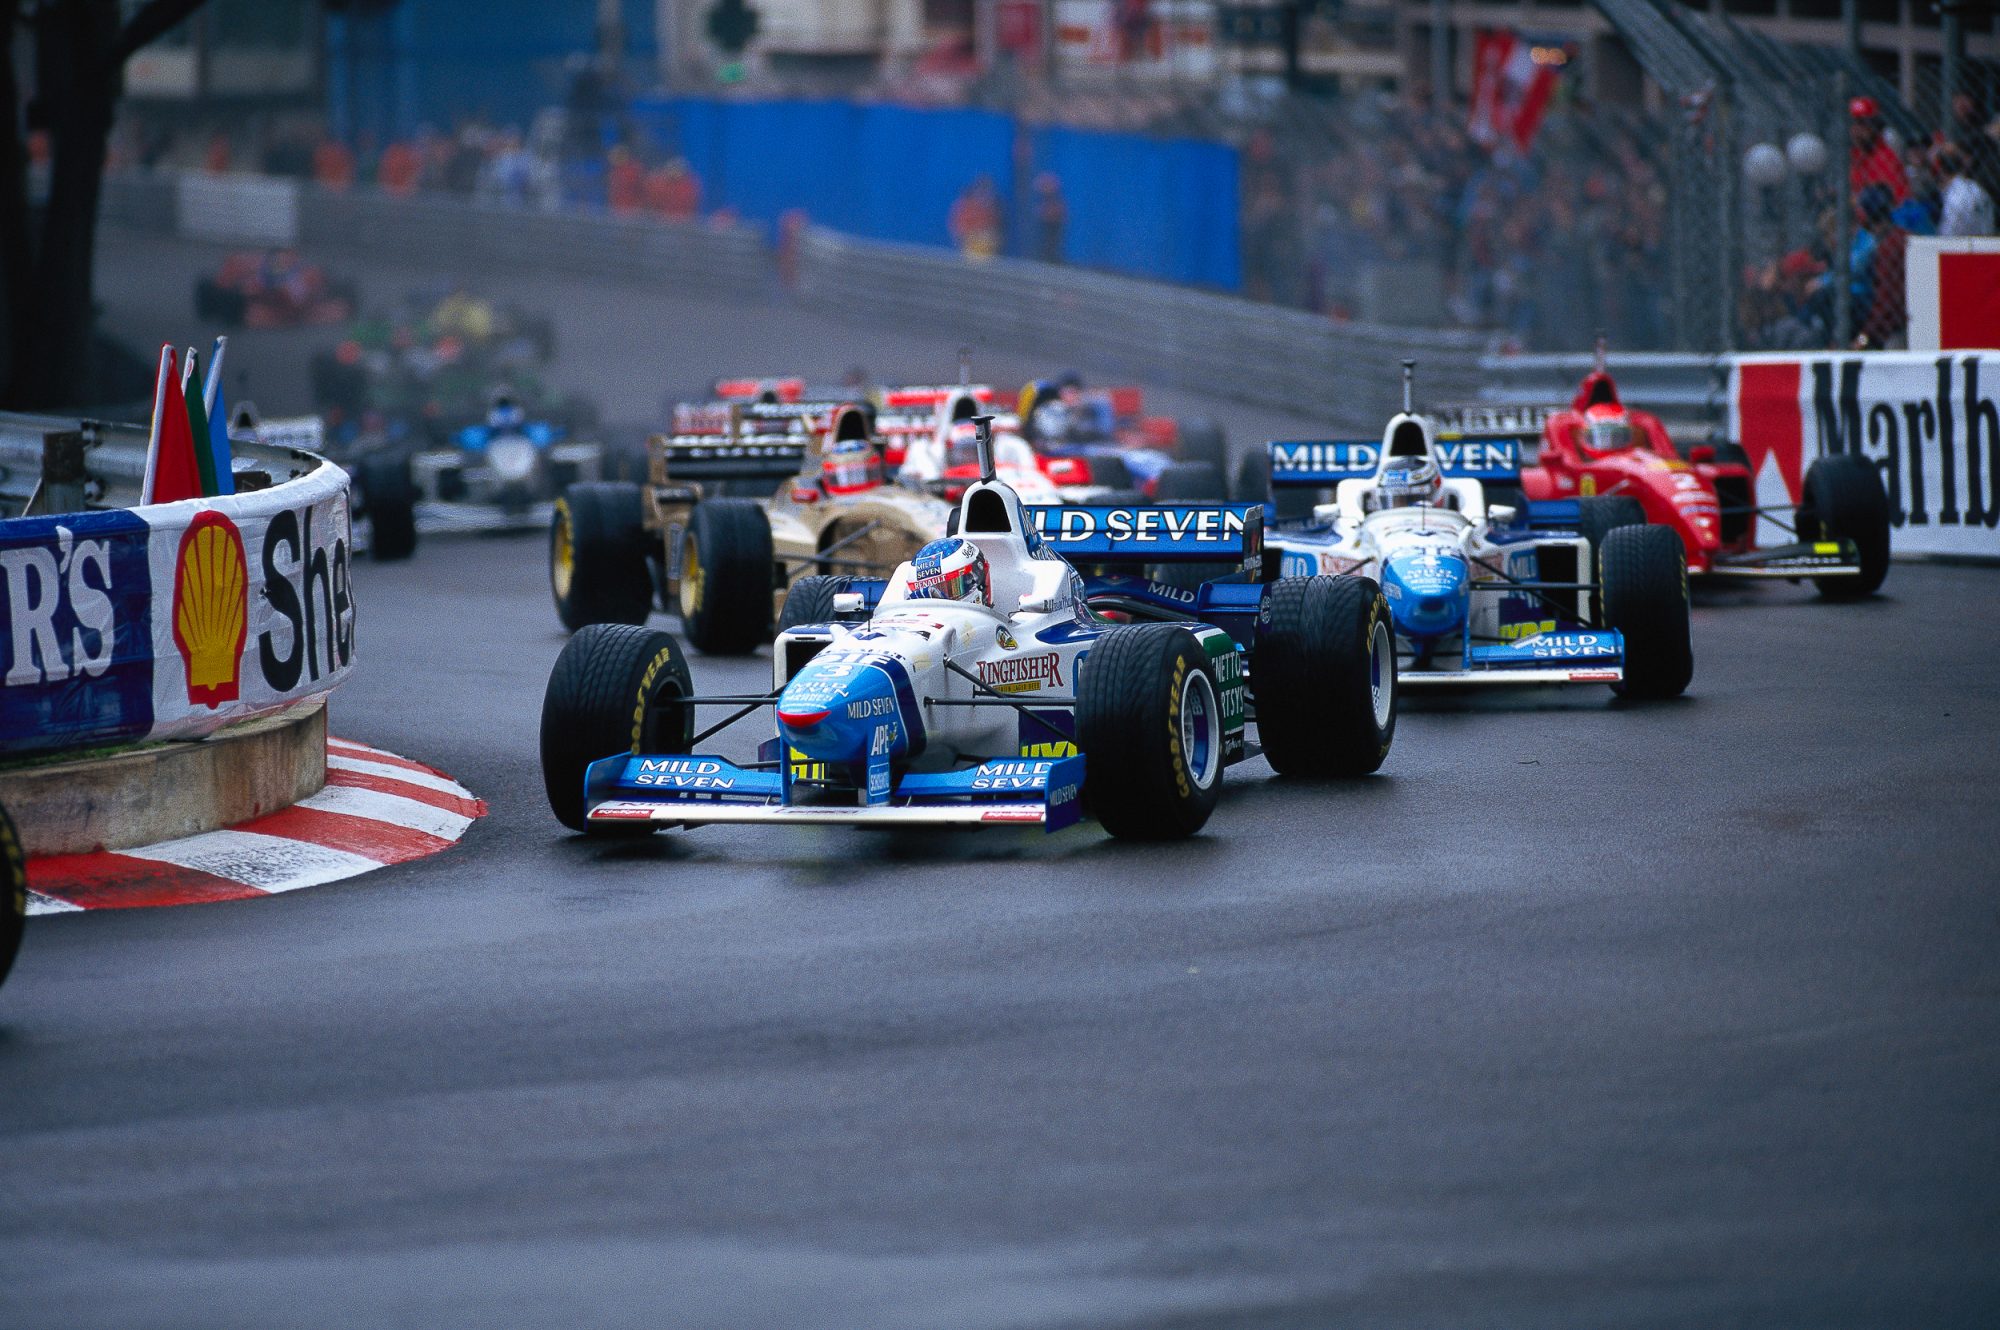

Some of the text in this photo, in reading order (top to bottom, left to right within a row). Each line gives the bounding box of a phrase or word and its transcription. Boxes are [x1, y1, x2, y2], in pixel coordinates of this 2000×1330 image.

[1273, 443, 1513, 472] MILD VEN
[1027, 511, 1096, 542] LD
[1105, 509, 1244, 542] SEVEN
[917, 560, 936, 571] MILD
[917, 566, 941, 579] SEVEN
[914, 574, 947, 590] RENAULT
[259, 490, 355, 693] She
[1148, 582, 1196, 604] MILD
[1533, 634, 1598, 649] MILD
[1533, 645, 1615, 658] SEVEN
[813, 664, 853, 678] 3
[976, 652, 1064, 688] KINGFISHER
[1212, 651, 1241, 683] NETTO
[847, 697, 895, 719] MILD SEVEN
[640, 759, 721, 774] MILD
[976, 762, 1053, 777] MILD
[634, 774, 735, 789] SEVEN
[971, 777, 1047, 790] SEVE
